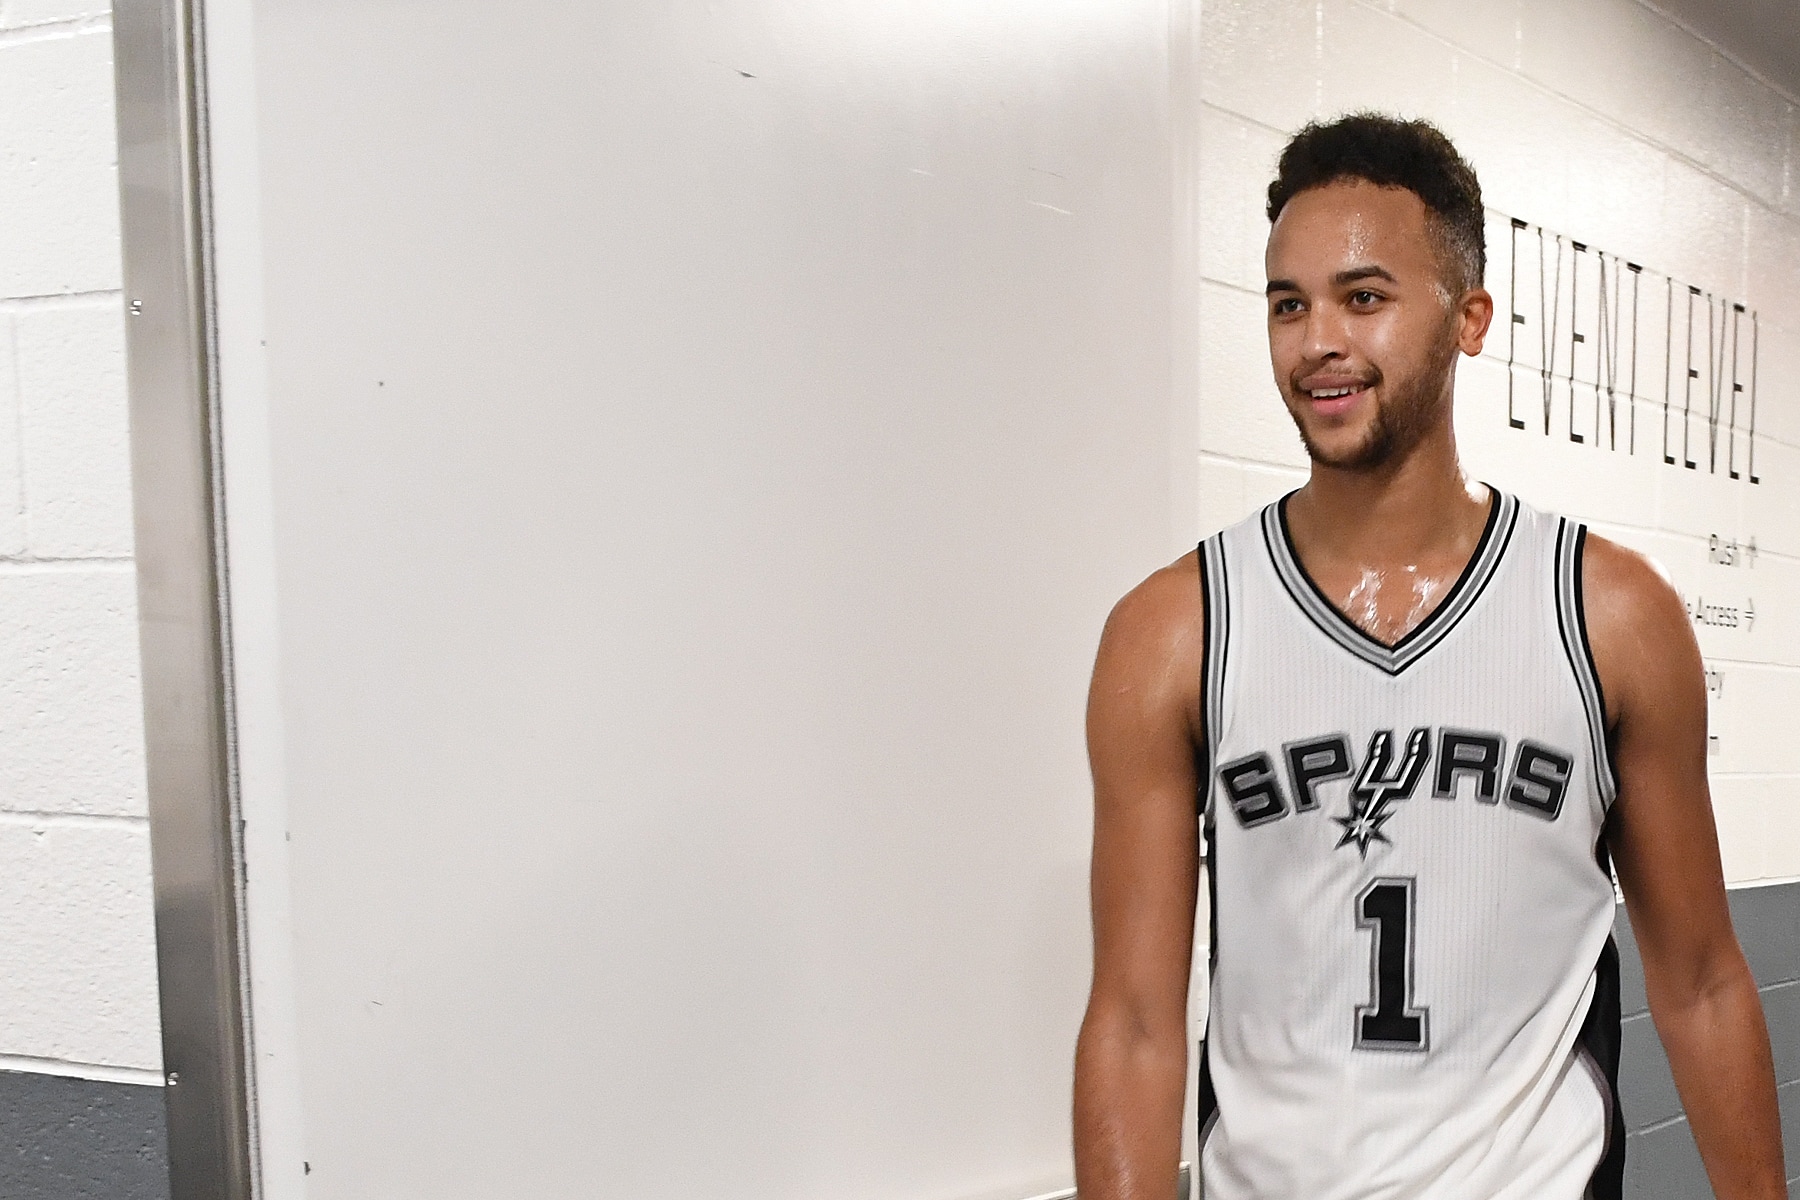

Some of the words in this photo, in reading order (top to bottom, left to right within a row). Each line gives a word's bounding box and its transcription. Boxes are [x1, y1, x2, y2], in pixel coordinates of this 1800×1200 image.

[1509, 217, 1642, 455] EVENT
[1663, 277, 1759, 485] LEVEL
[1216, 727, 1574, 859] SPURS
[1352, 876, 1430, 1052] 1
